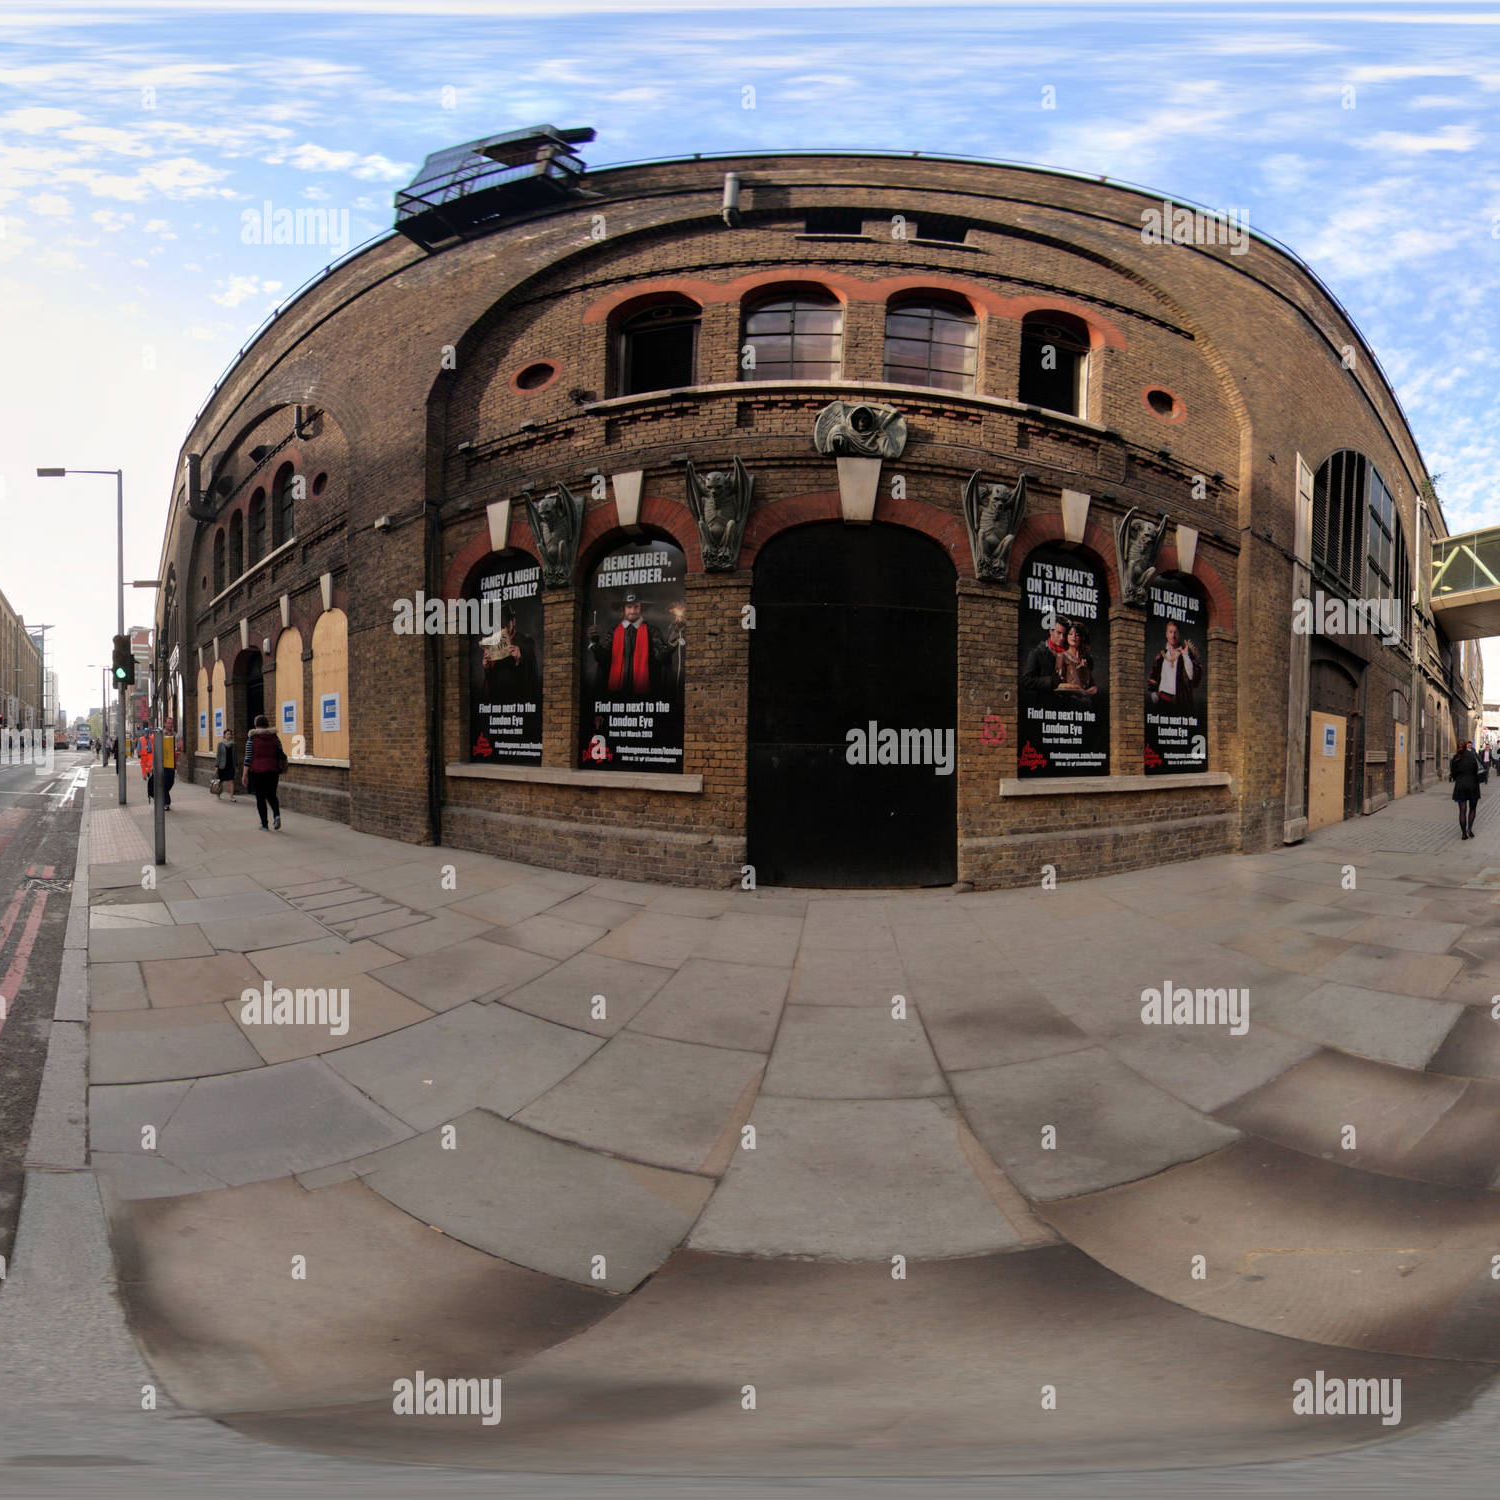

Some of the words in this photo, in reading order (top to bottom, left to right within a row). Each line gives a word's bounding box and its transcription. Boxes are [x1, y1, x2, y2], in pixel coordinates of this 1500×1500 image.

[603, 552, 671, 571] REMEMBER,
[481, 572, 505, 590] FANCY
[507, 572, 513, 585] A
[515, 566, 540, 583] NIGHT
[598, 568, 676, 588] REMEMBER...
[1032, 562, 1053, 579] IT'S
[1055, 566, 1094, 587] WHAT'S
[482, 589, 501, 604] TIME
[503, 582, 538, 601] STROLL?
[1027, 577, 1042, 593] ON
[1044, 580, 1064, 597] THE
[1066, 584, 1098, 603] INSIDE
[1027, 594, 1055, 612] THAT
[1057, 599, 1096, 619] COUNTS
[1153, 602, 1165, 617] DO
[1163, 590, 1188, 608] DEATH
[1189, 597, 1200, 612] US
[479, 704, 491, 713] Find
[492, 705, 501, 713] me
[502, 704, 516, 713] next
[517, 704, 524, 713] to
[525, 702, 536, 713] the
[595, 701, 611, 713] Find
[612, 703, 624, 713] me
[626, 702, 644, 713] next
[646, 702, 654, 713] to
[656, 701, 670, 713] the
[1028, 708, 1043, 719] Find
[1045, 710, 1057, 720] me
[1058, 711, 1074, 721] next
[1075, 711, 1082, 721] to
[1084, 711, 1095, 722] the
[490, 715, 511, 725] London
[512, 715, 523, 727] Eye
[609, 715, 637, 727] London
[639, 716, 653, 729] Eye
[1042, 722, 1069, 734] London
[1070, 724, 1082, 736] Eye
